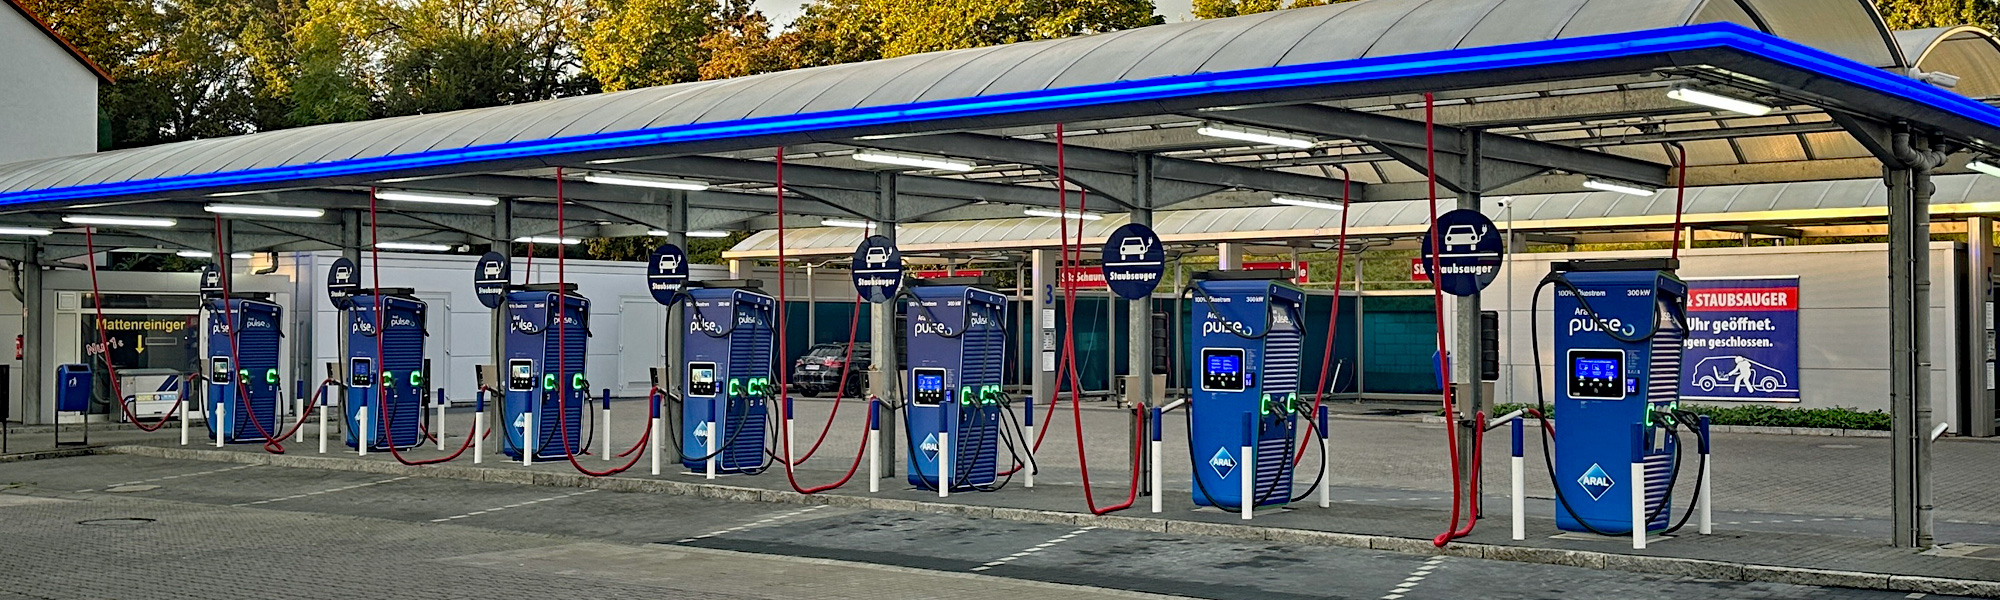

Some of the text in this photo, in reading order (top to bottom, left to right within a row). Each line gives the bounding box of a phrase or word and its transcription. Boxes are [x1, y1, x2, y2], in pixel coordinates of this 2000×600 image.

[1109, 270, 1157, 282] Staubsauger
[1431, 263, 1493, 275] Saubsauger
[1045, 284, 1053, 305] 3
[1695, 291, 1789, 307] STAUBSAUGER
[1574, 307, 1589, 316] Ara
[95, 318, 186, 333] Mattenreiniger
[352, 320, 372, 335] plse
[1569, 312, 1621, 336] pulse
[1687, 316, 1776, 335] Uhr geöffnet.
[1708, 336, 1774, 350] geschlossen.
[921, 443, 939, 451] ARAL
[1213, 458, 1233, 467] ARAL
[1583, 475, 1609, 487] ARAL
